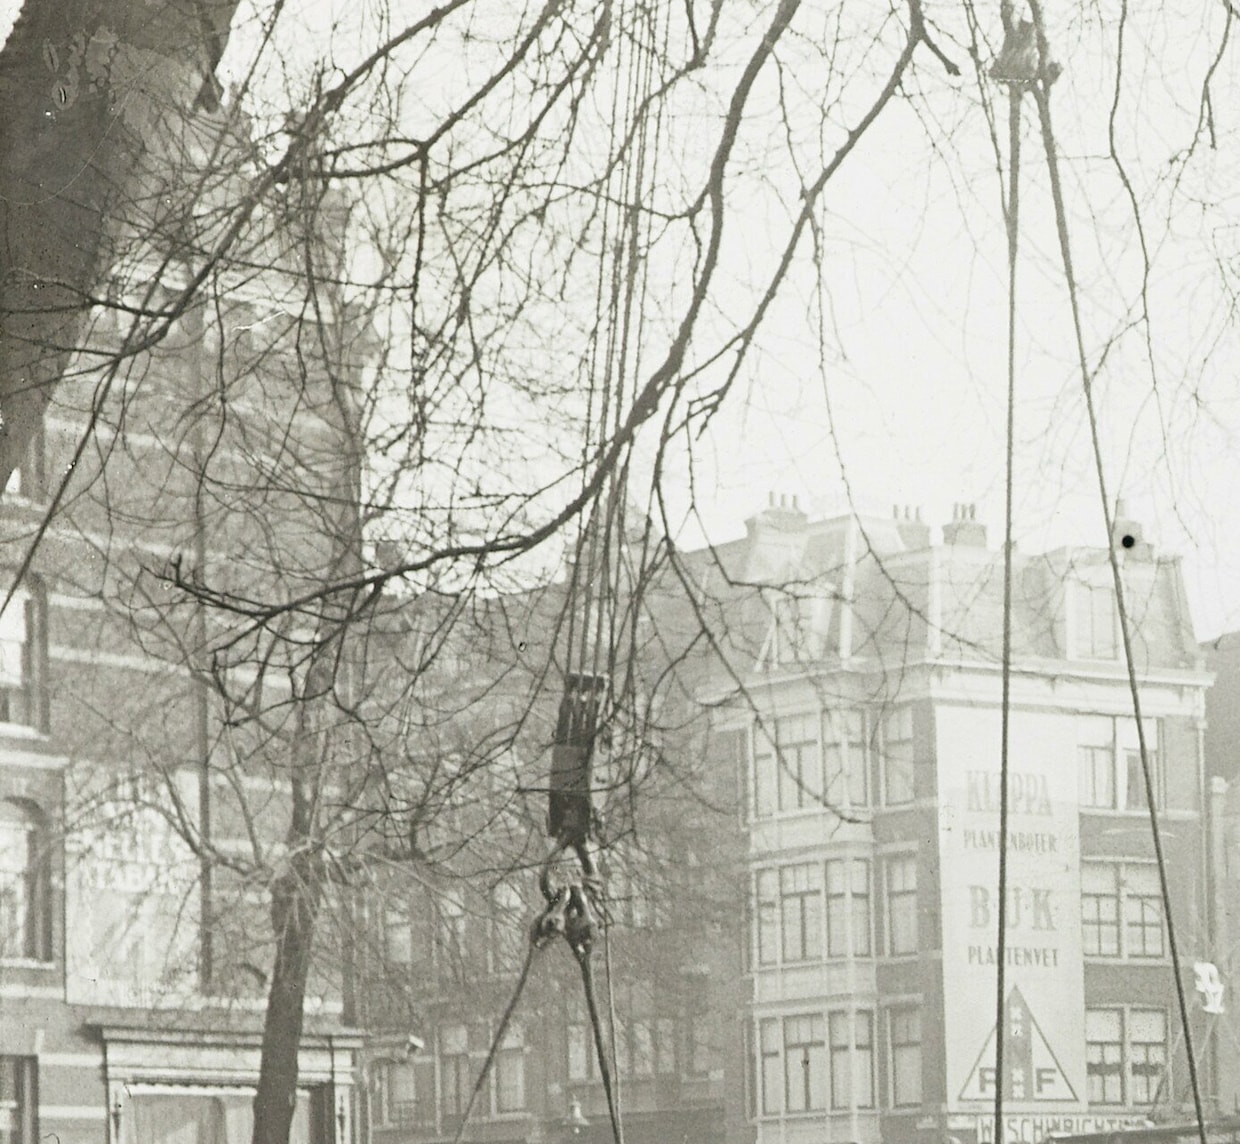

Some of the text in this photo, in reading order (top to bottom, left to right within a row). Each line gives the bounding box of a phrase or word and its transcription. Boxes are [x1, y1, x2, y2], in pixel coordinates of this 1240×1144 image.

[966, 769, 1054, 817] KLPPA
[963, 828, 1058, 853] PLANTNBOTER
[967, 945, 1059, 969] PLATENVET
